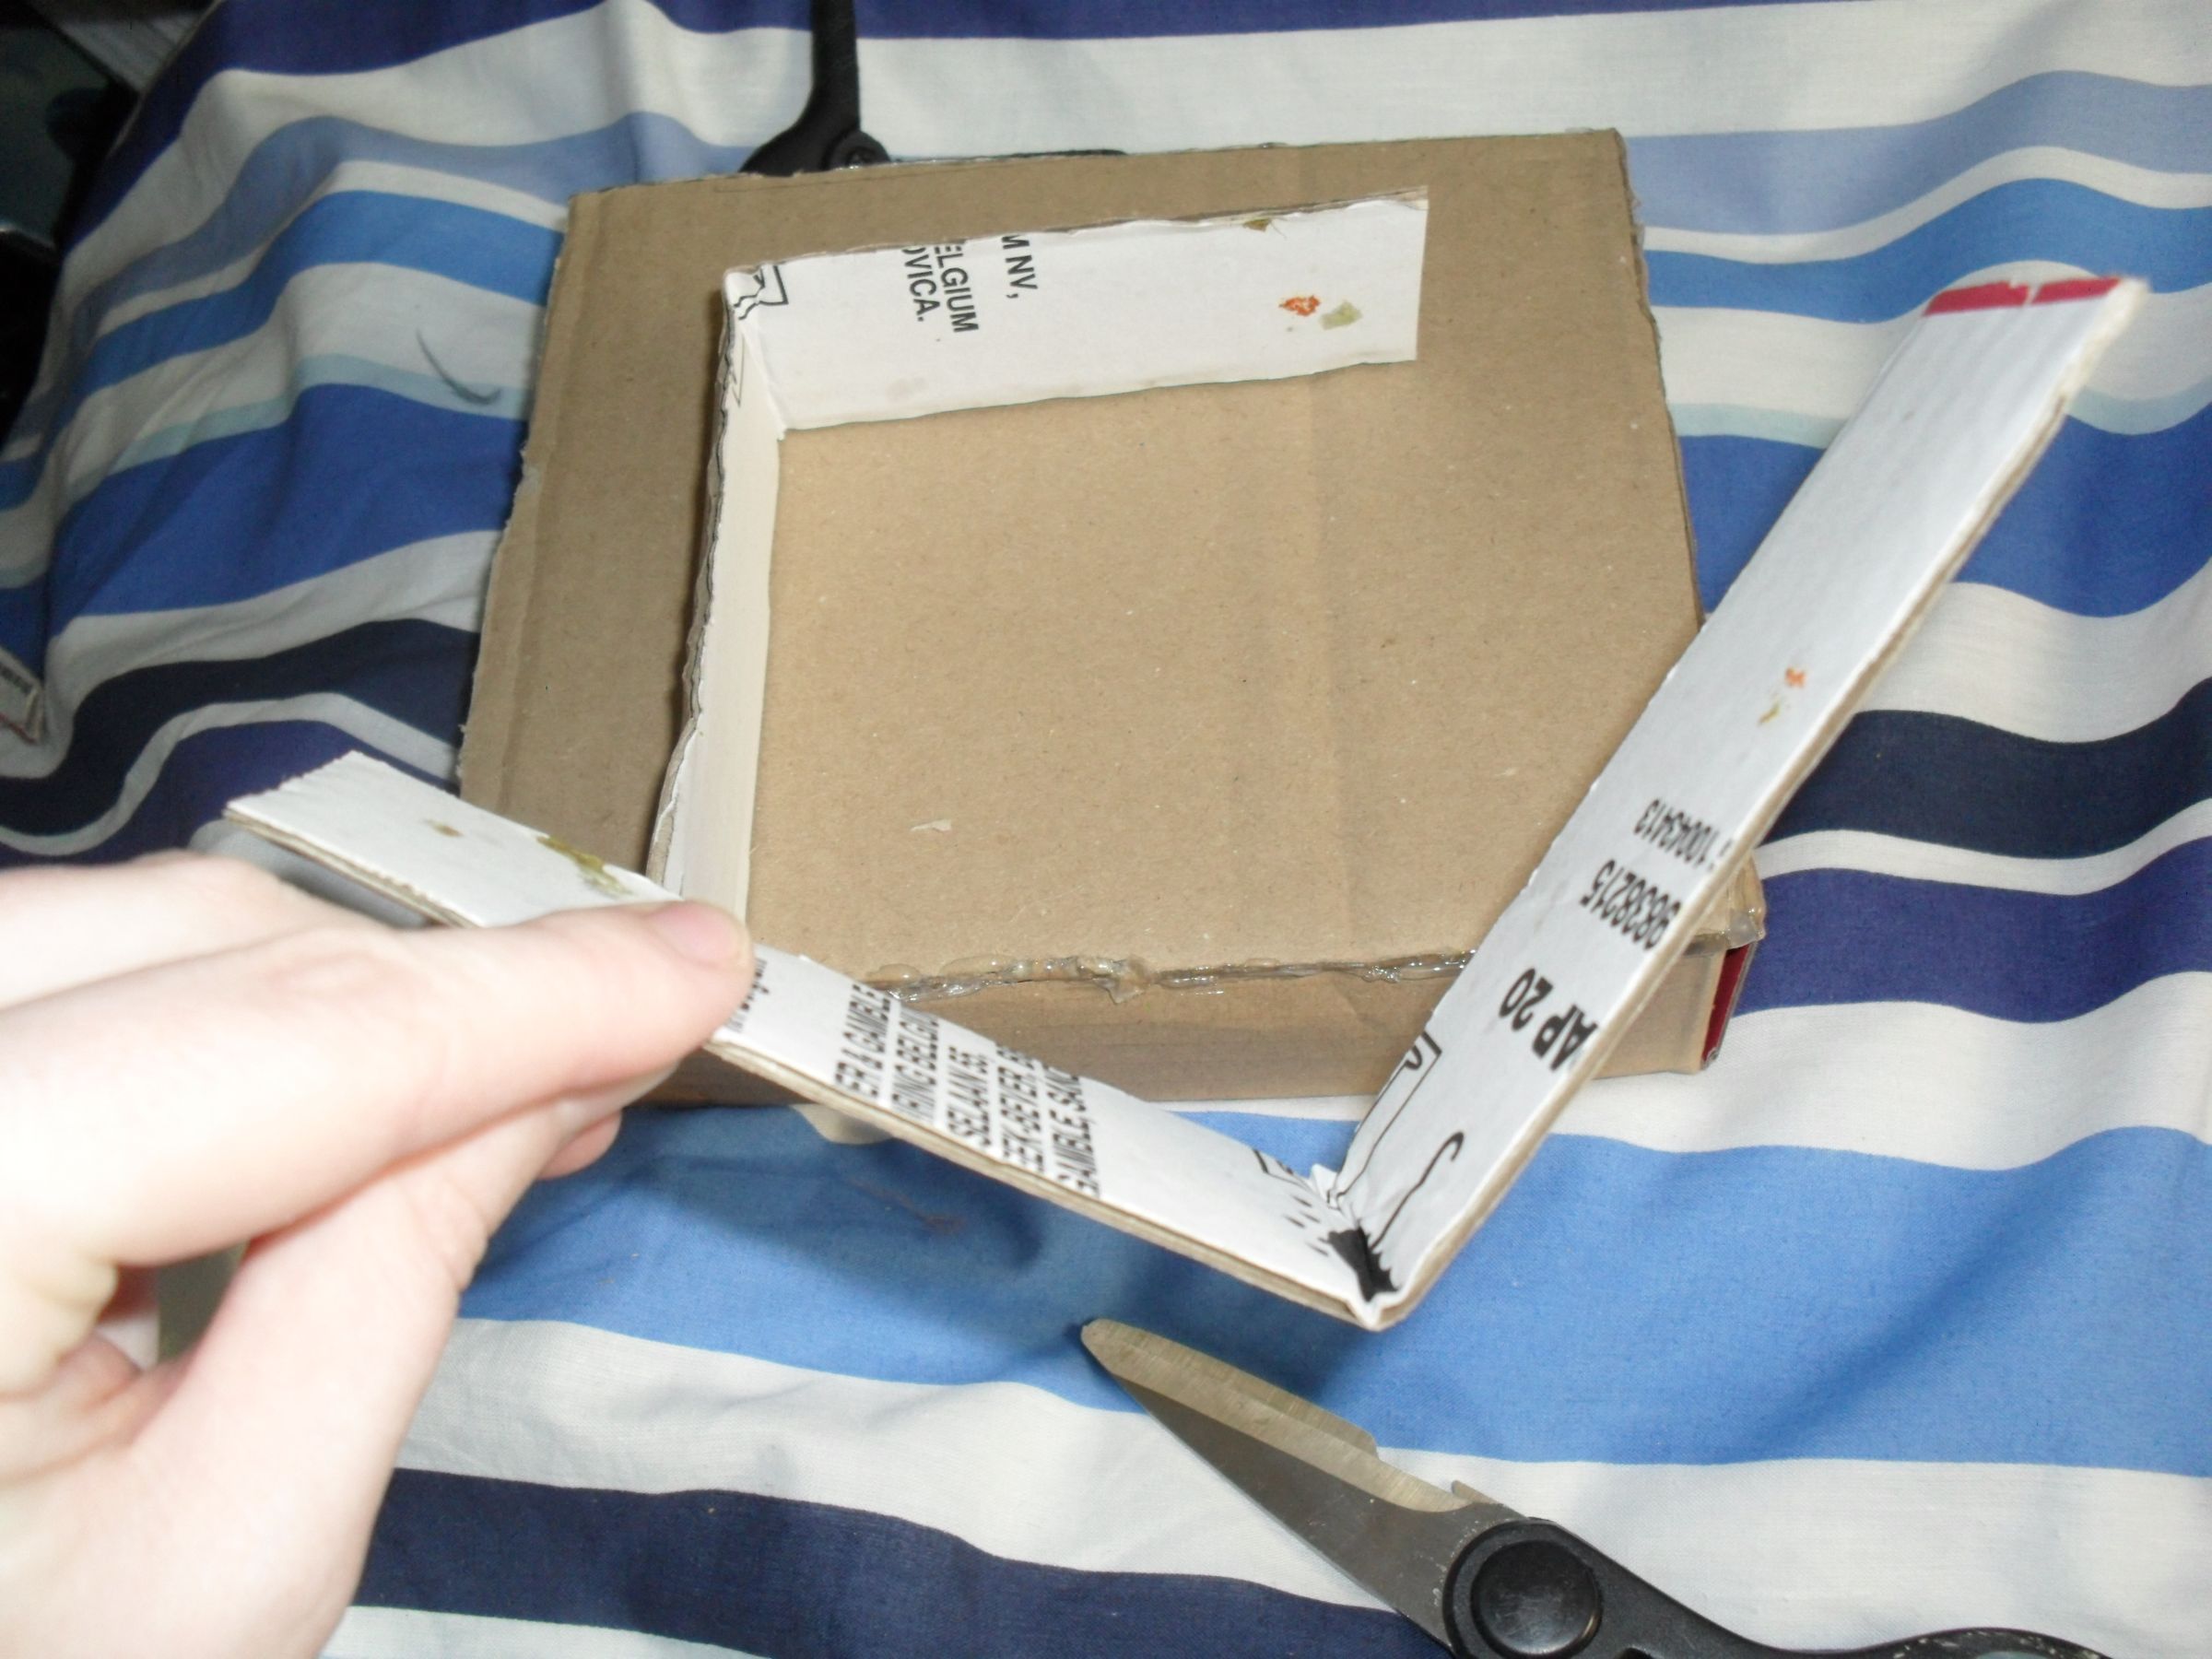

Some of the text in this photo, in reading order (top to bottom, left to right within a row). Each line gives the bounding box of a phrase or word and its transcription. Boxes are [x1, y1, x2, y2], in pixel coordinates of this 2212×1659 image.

[1005, 254, 1038, 299] NV,
[842, 982, 892, 1054] GAMBLE
[1498, 967, 1554, 1032] 20
[841, 1047, 884, 1070] &
